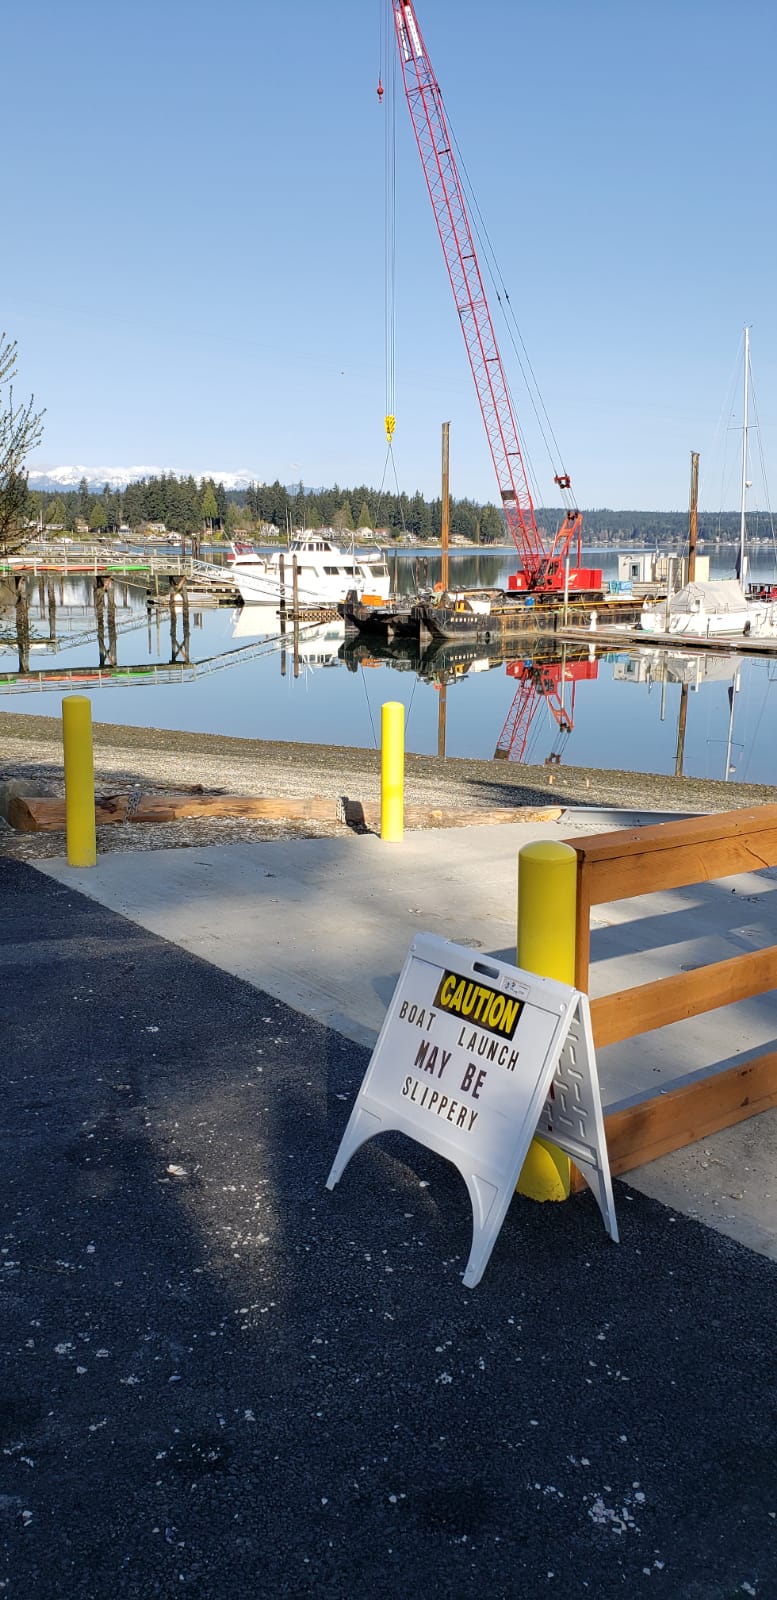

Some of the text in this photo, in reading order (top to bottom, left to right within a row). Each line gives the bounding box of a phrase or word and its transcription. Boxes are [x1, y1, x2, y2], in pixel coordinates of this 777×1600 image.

[440, 976, 520, 1033] CAUTION
[399, 1001, 520, 1072] BOAT LAUNCH
[414, 1040, 487, 1098] MAY BE
[402, 1076, 478, 1132] SLIPPERY
